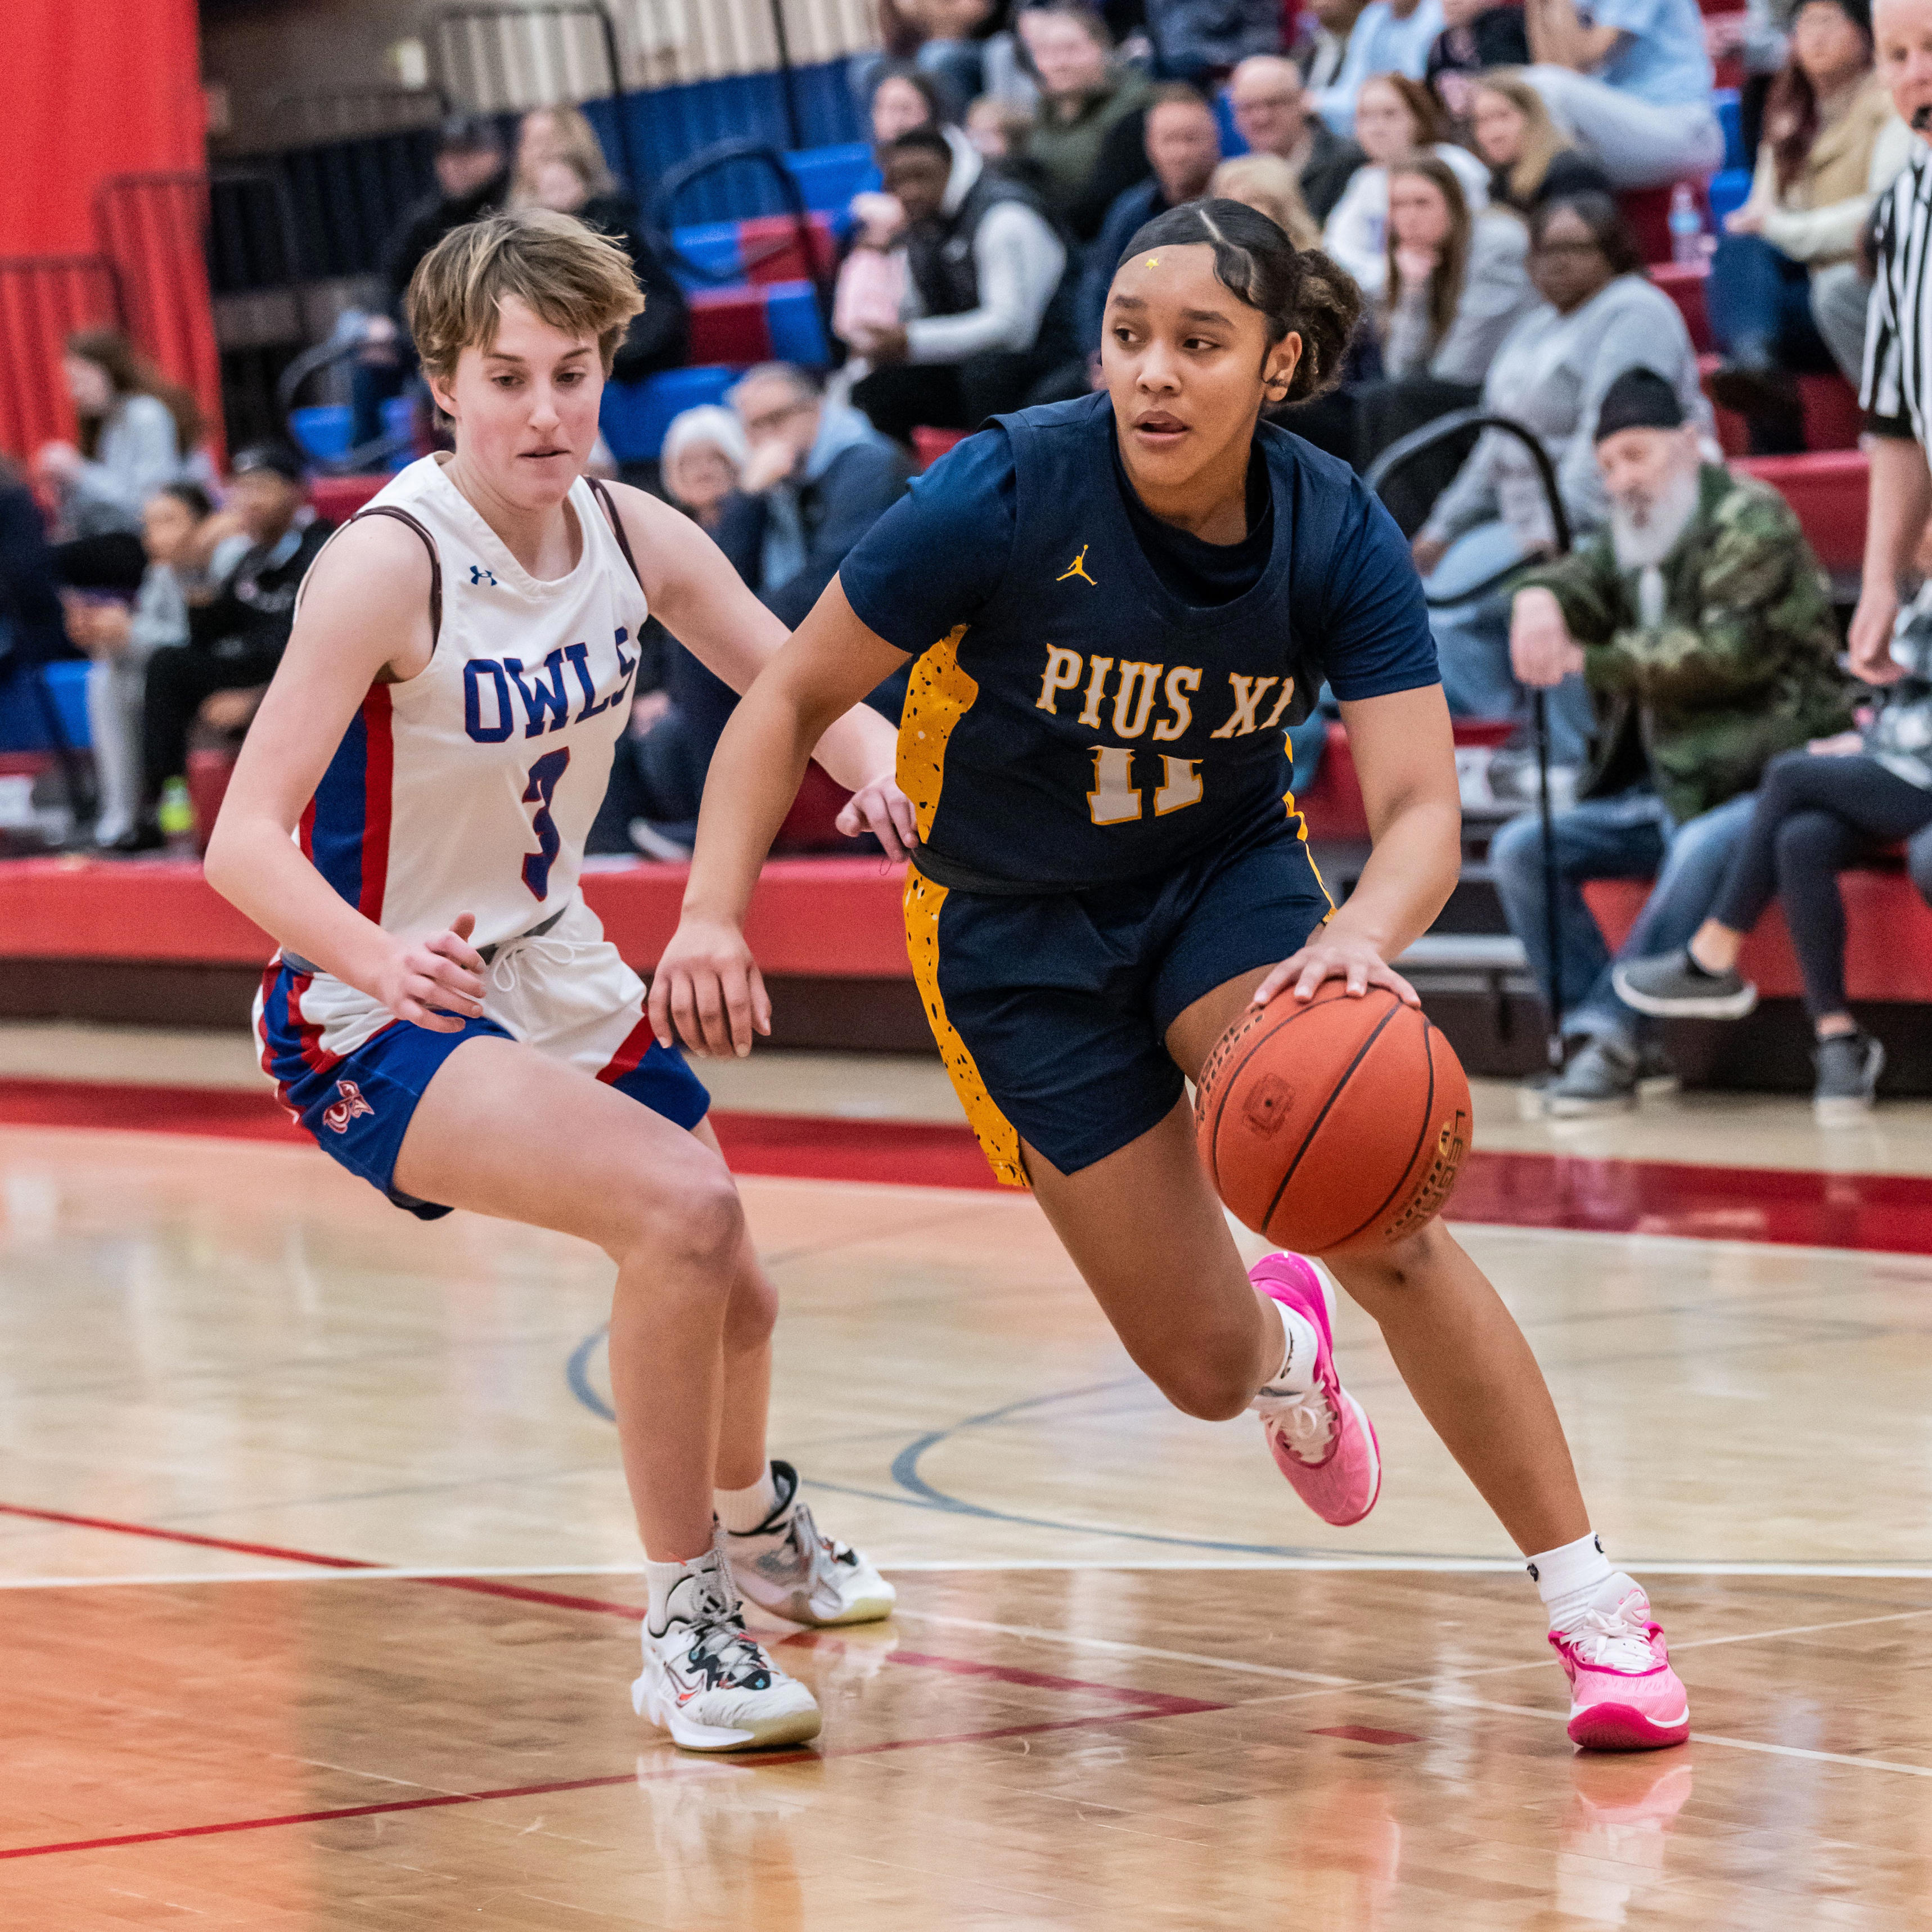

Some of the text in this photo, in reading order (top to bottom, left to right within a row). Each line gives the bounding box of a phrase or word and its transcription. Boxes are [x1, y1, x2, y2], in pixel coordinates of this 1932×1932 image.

[463, 627, 636, 743] OWLS
[1035, 642, 1295, 741] PIUS XI
[521, 746, 570, 902] 3
[1086, 744, 1204, 826] 11
